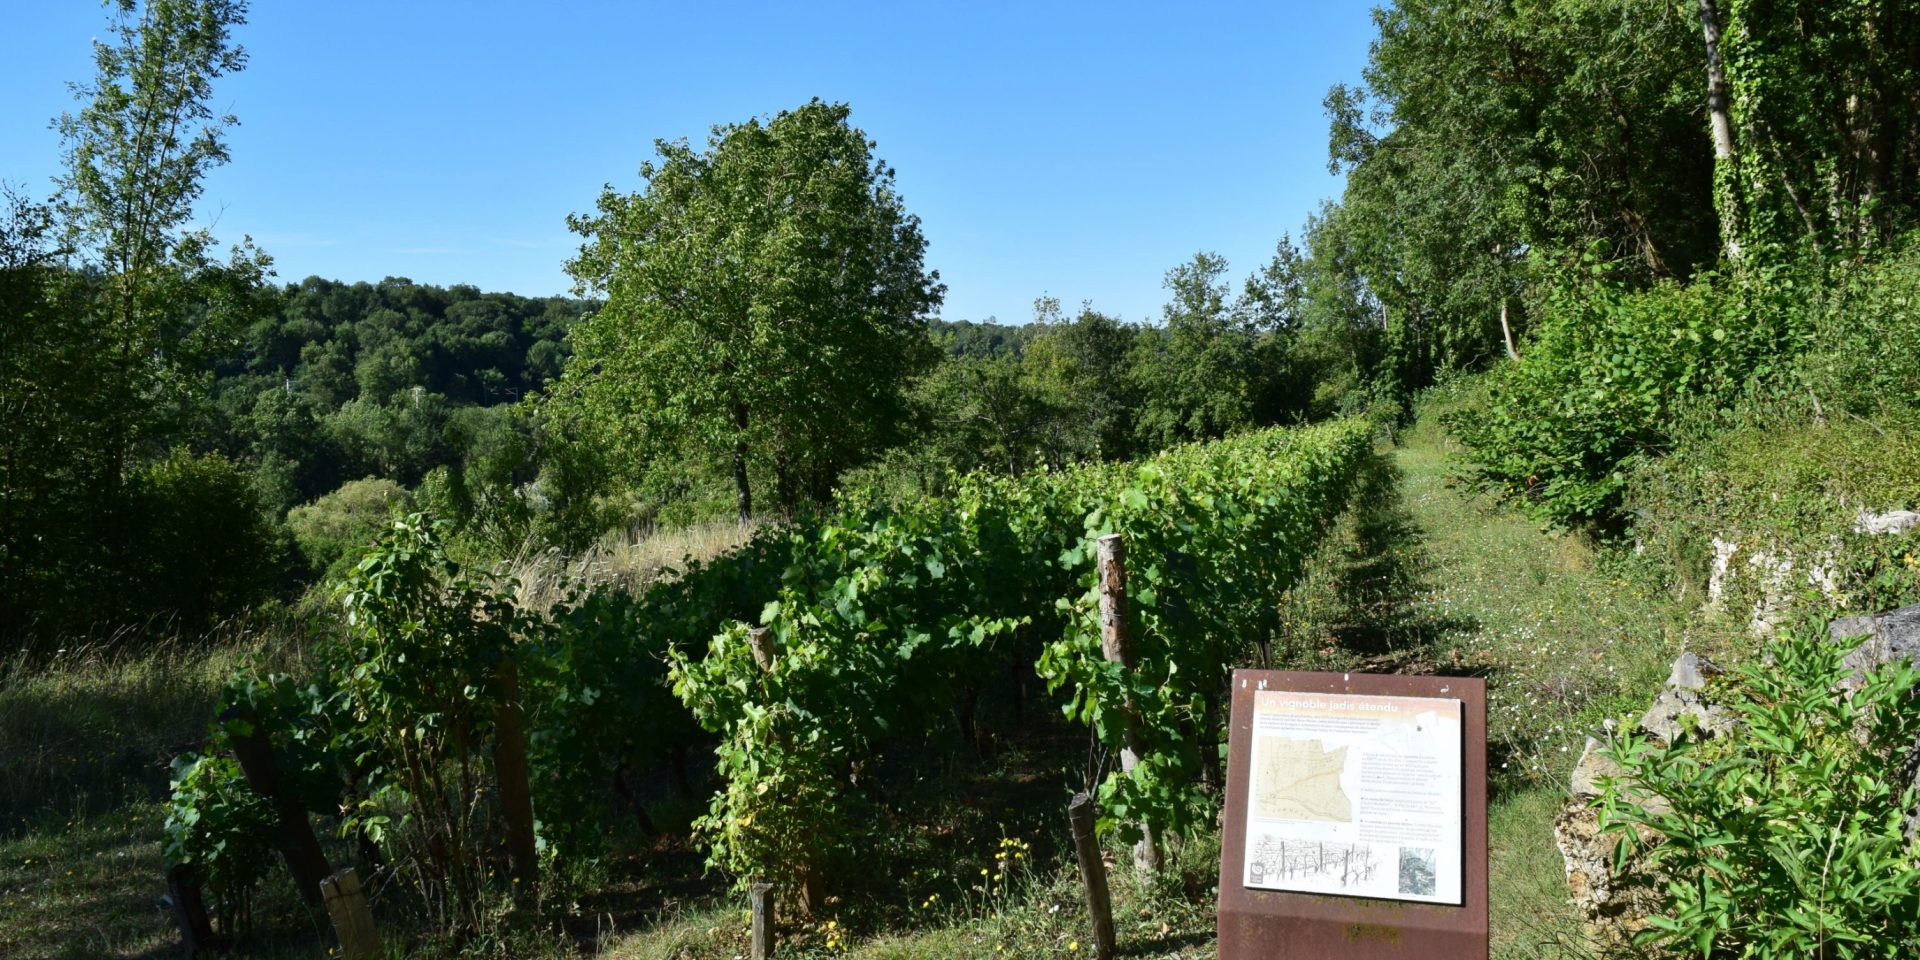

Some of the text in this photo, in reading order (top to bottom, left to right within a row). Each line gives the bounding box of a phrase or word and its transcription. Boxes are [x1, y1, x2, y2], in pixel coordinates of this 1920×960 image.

[1261, 697, 1398, 713] Un vignoble jadis étendu
